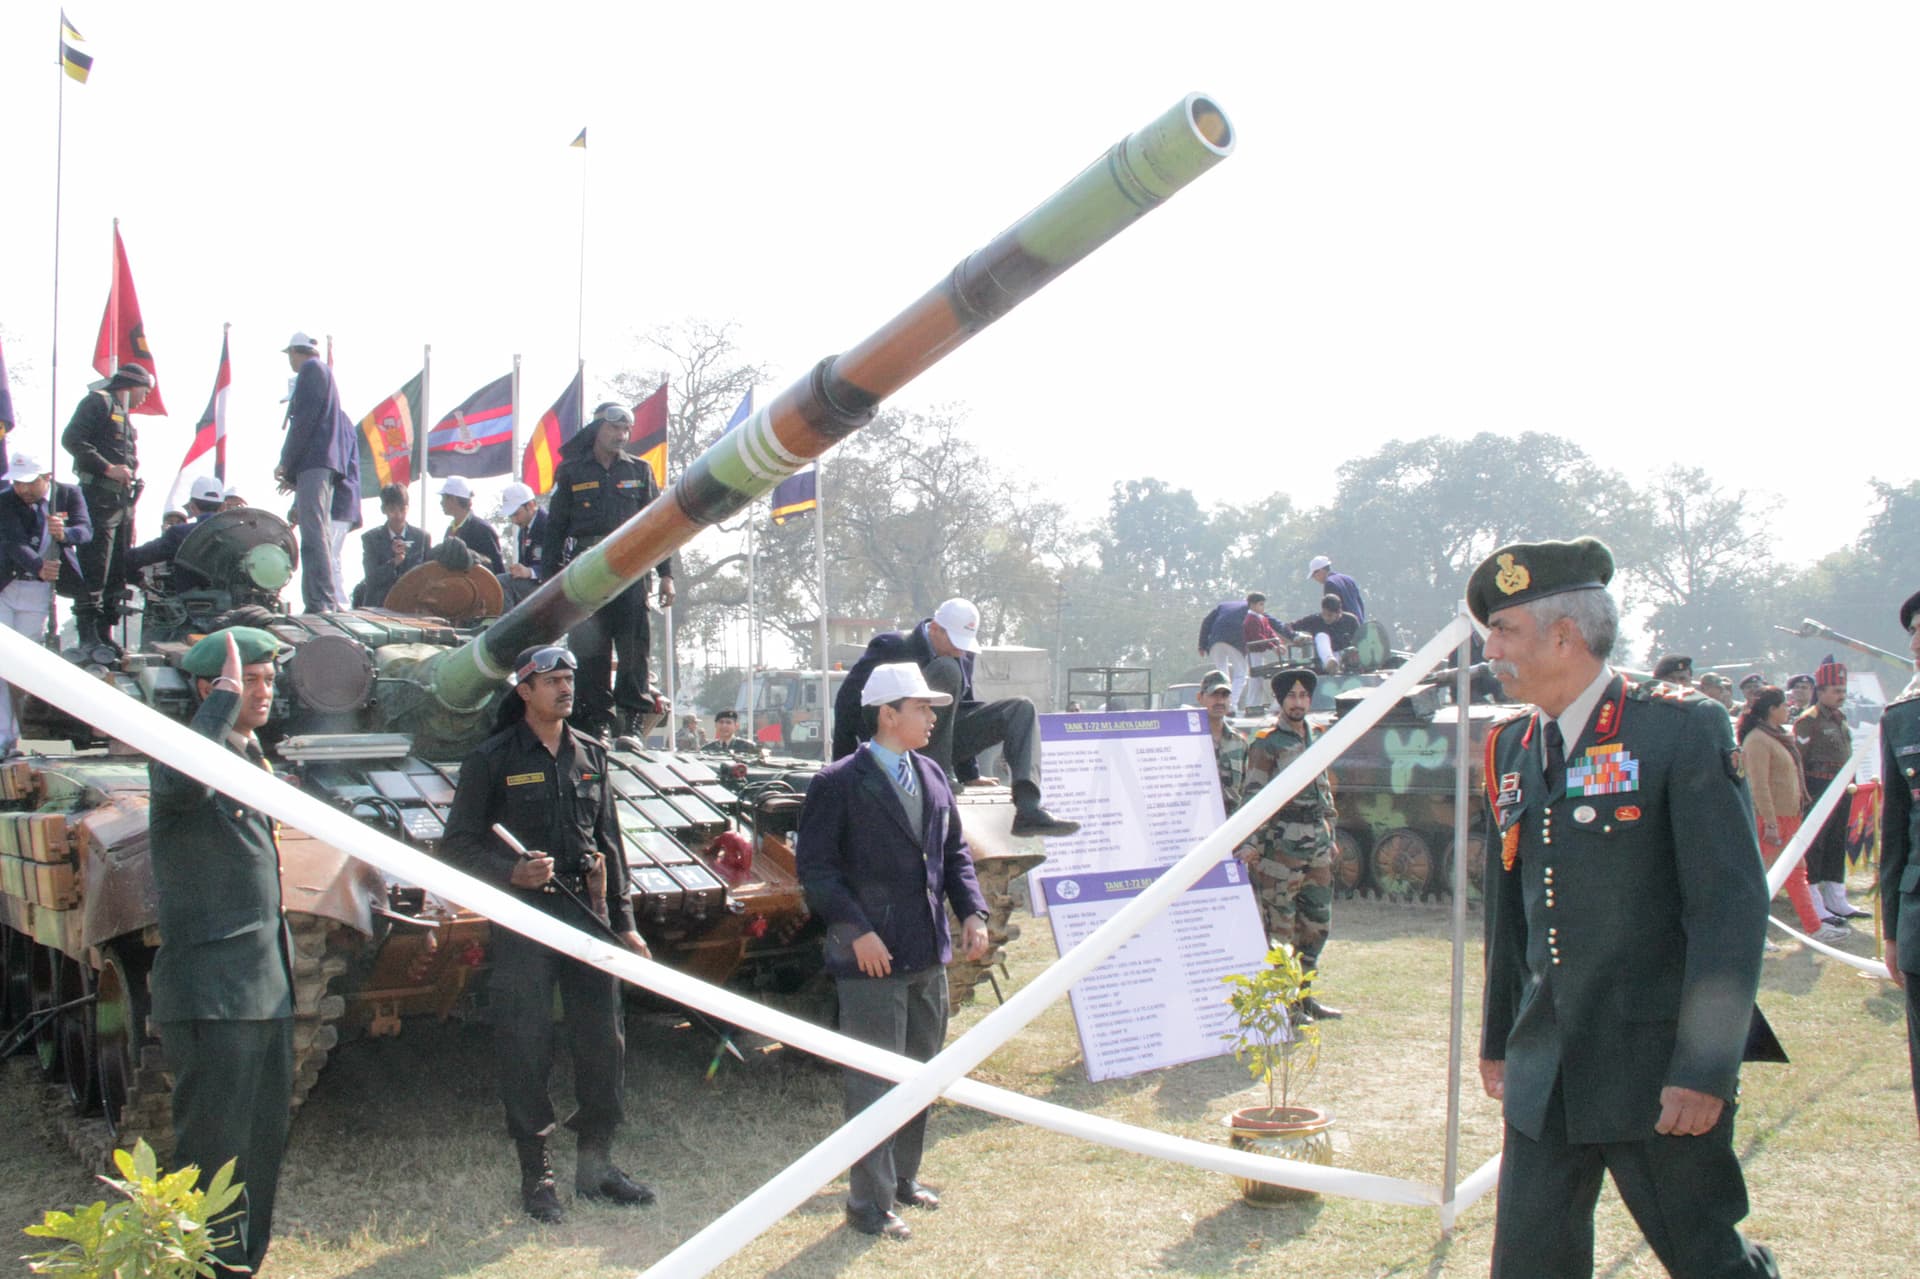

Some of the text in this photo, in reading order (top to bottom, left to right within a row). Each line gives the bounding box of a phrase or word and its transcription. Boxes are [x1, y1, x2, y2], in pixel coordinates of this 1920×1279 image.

[1064, 722, 1083, 731] TANK
[1085, 721, 1100, 731] T-72
[1104, 881, 1123, 891] TANK
[1125, 879, 1140, 890] T-72
